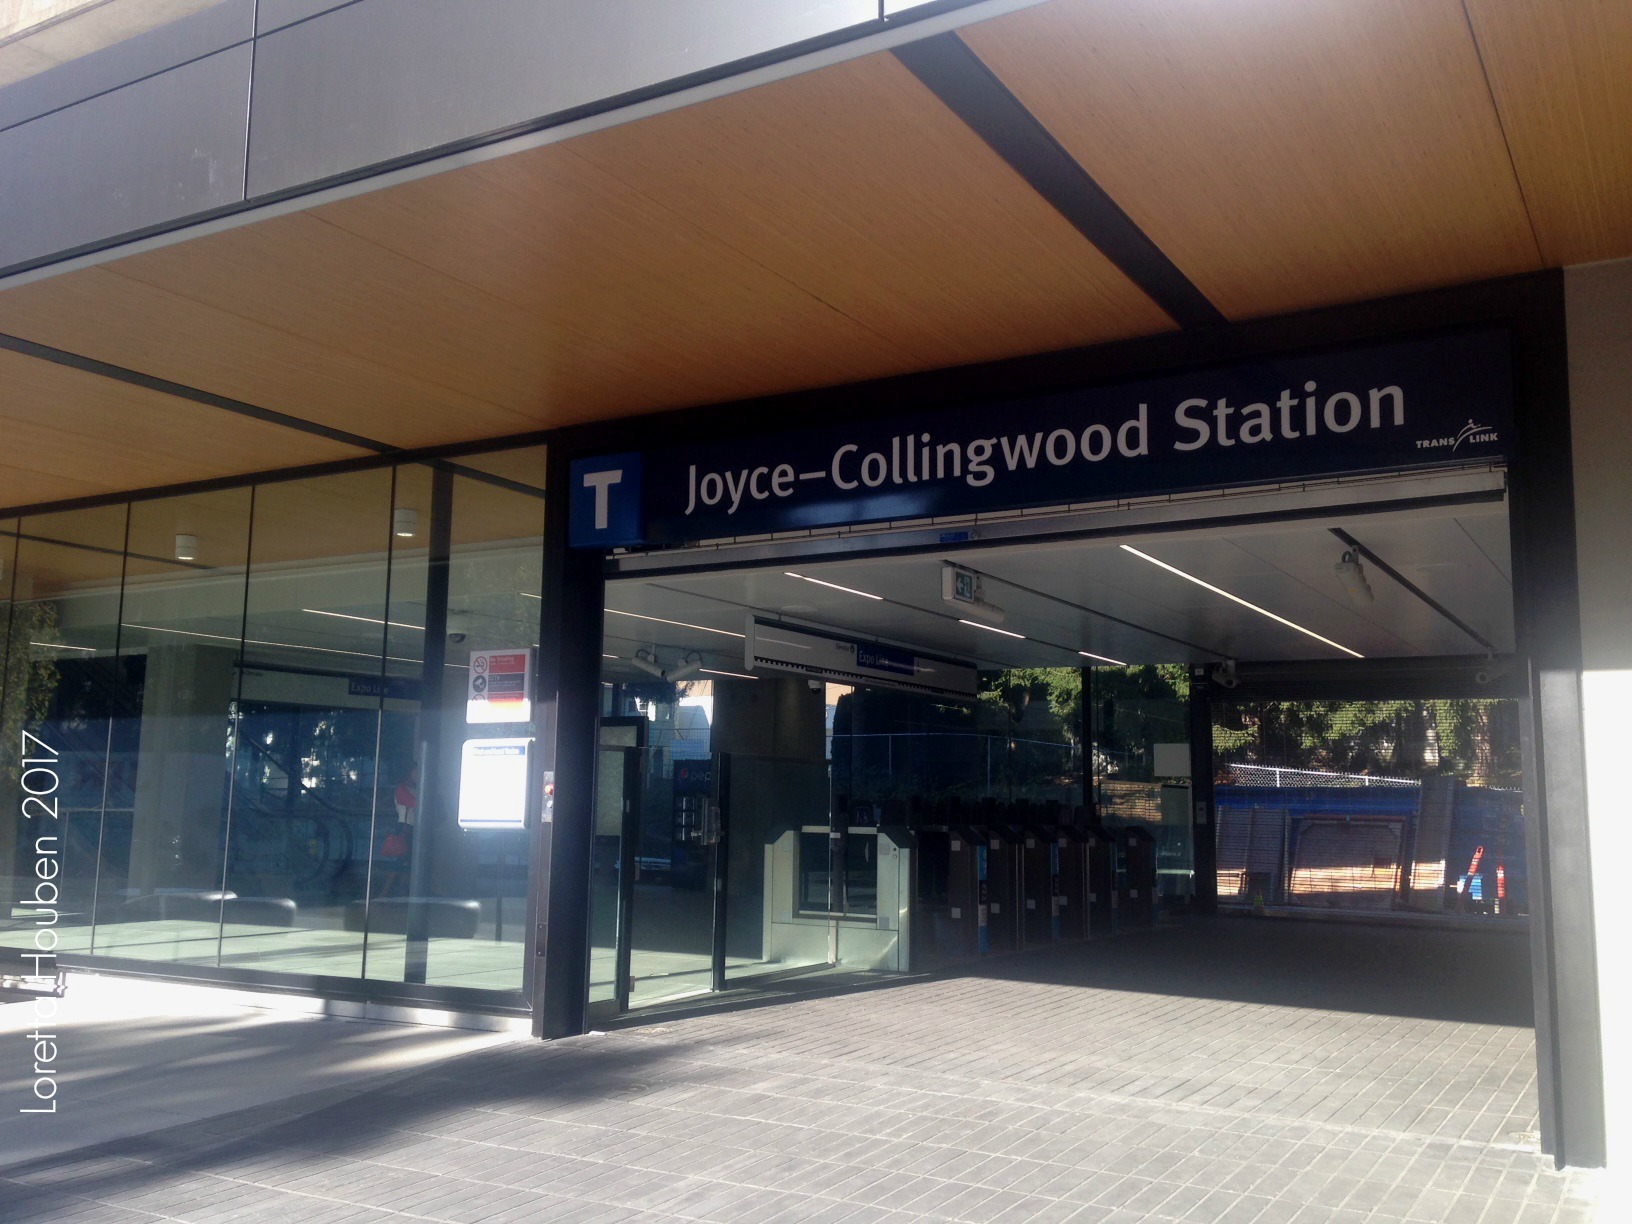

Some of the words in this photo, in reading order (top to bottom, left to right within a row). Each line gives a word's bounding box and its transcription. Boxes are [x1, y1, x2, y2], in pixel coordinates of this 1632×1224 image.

[1173, 380, 1406, 452] Station
[1415, 437, 1456, 449] TRANS
[1469, 432, 1499, 443] LINK
[582, 469, 623, 531] T
[858, 650, 875, 666] Expo
[351, 682, 372, 695] Expo
